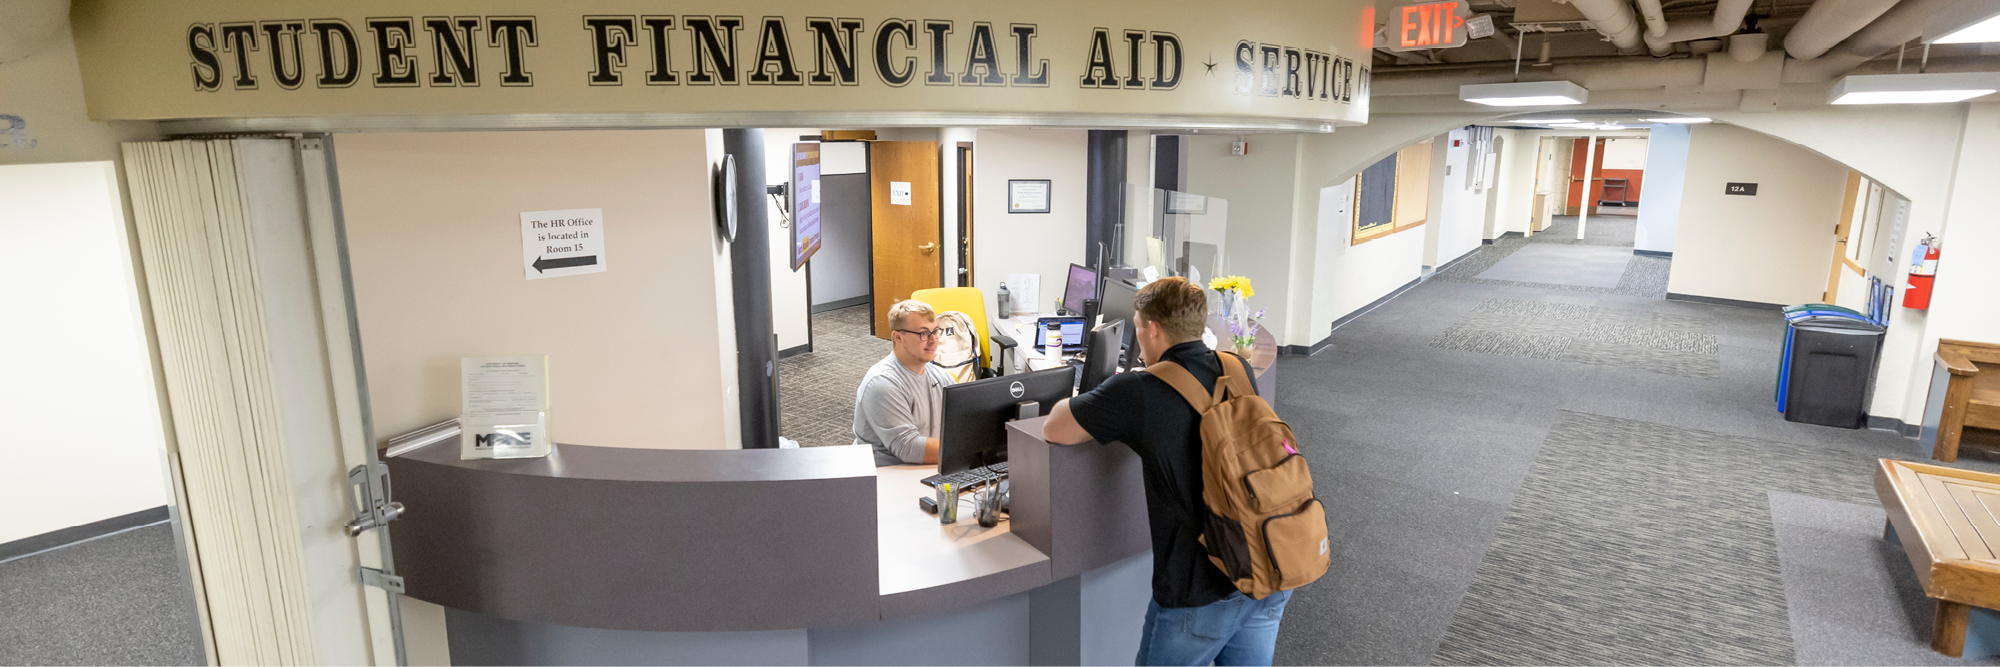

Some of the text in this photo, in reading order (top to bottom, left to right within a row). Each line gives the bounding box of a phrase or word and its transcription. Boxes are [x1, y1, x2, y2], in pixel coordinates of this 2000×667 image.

[1401, 2, 1458, 47] EXIT
[186, 16, 538, 92] STUDENT
[582, 15, 1050, 88] FINANCIAL
[1079, 27, 1184, 91] AID
[1233, 39, 1352, 104] SERVICE
[531, 218, 593, 229] The HR Office
[538, 231, 589, 241] is located in
[546, 243, 584, 254] Room 15
